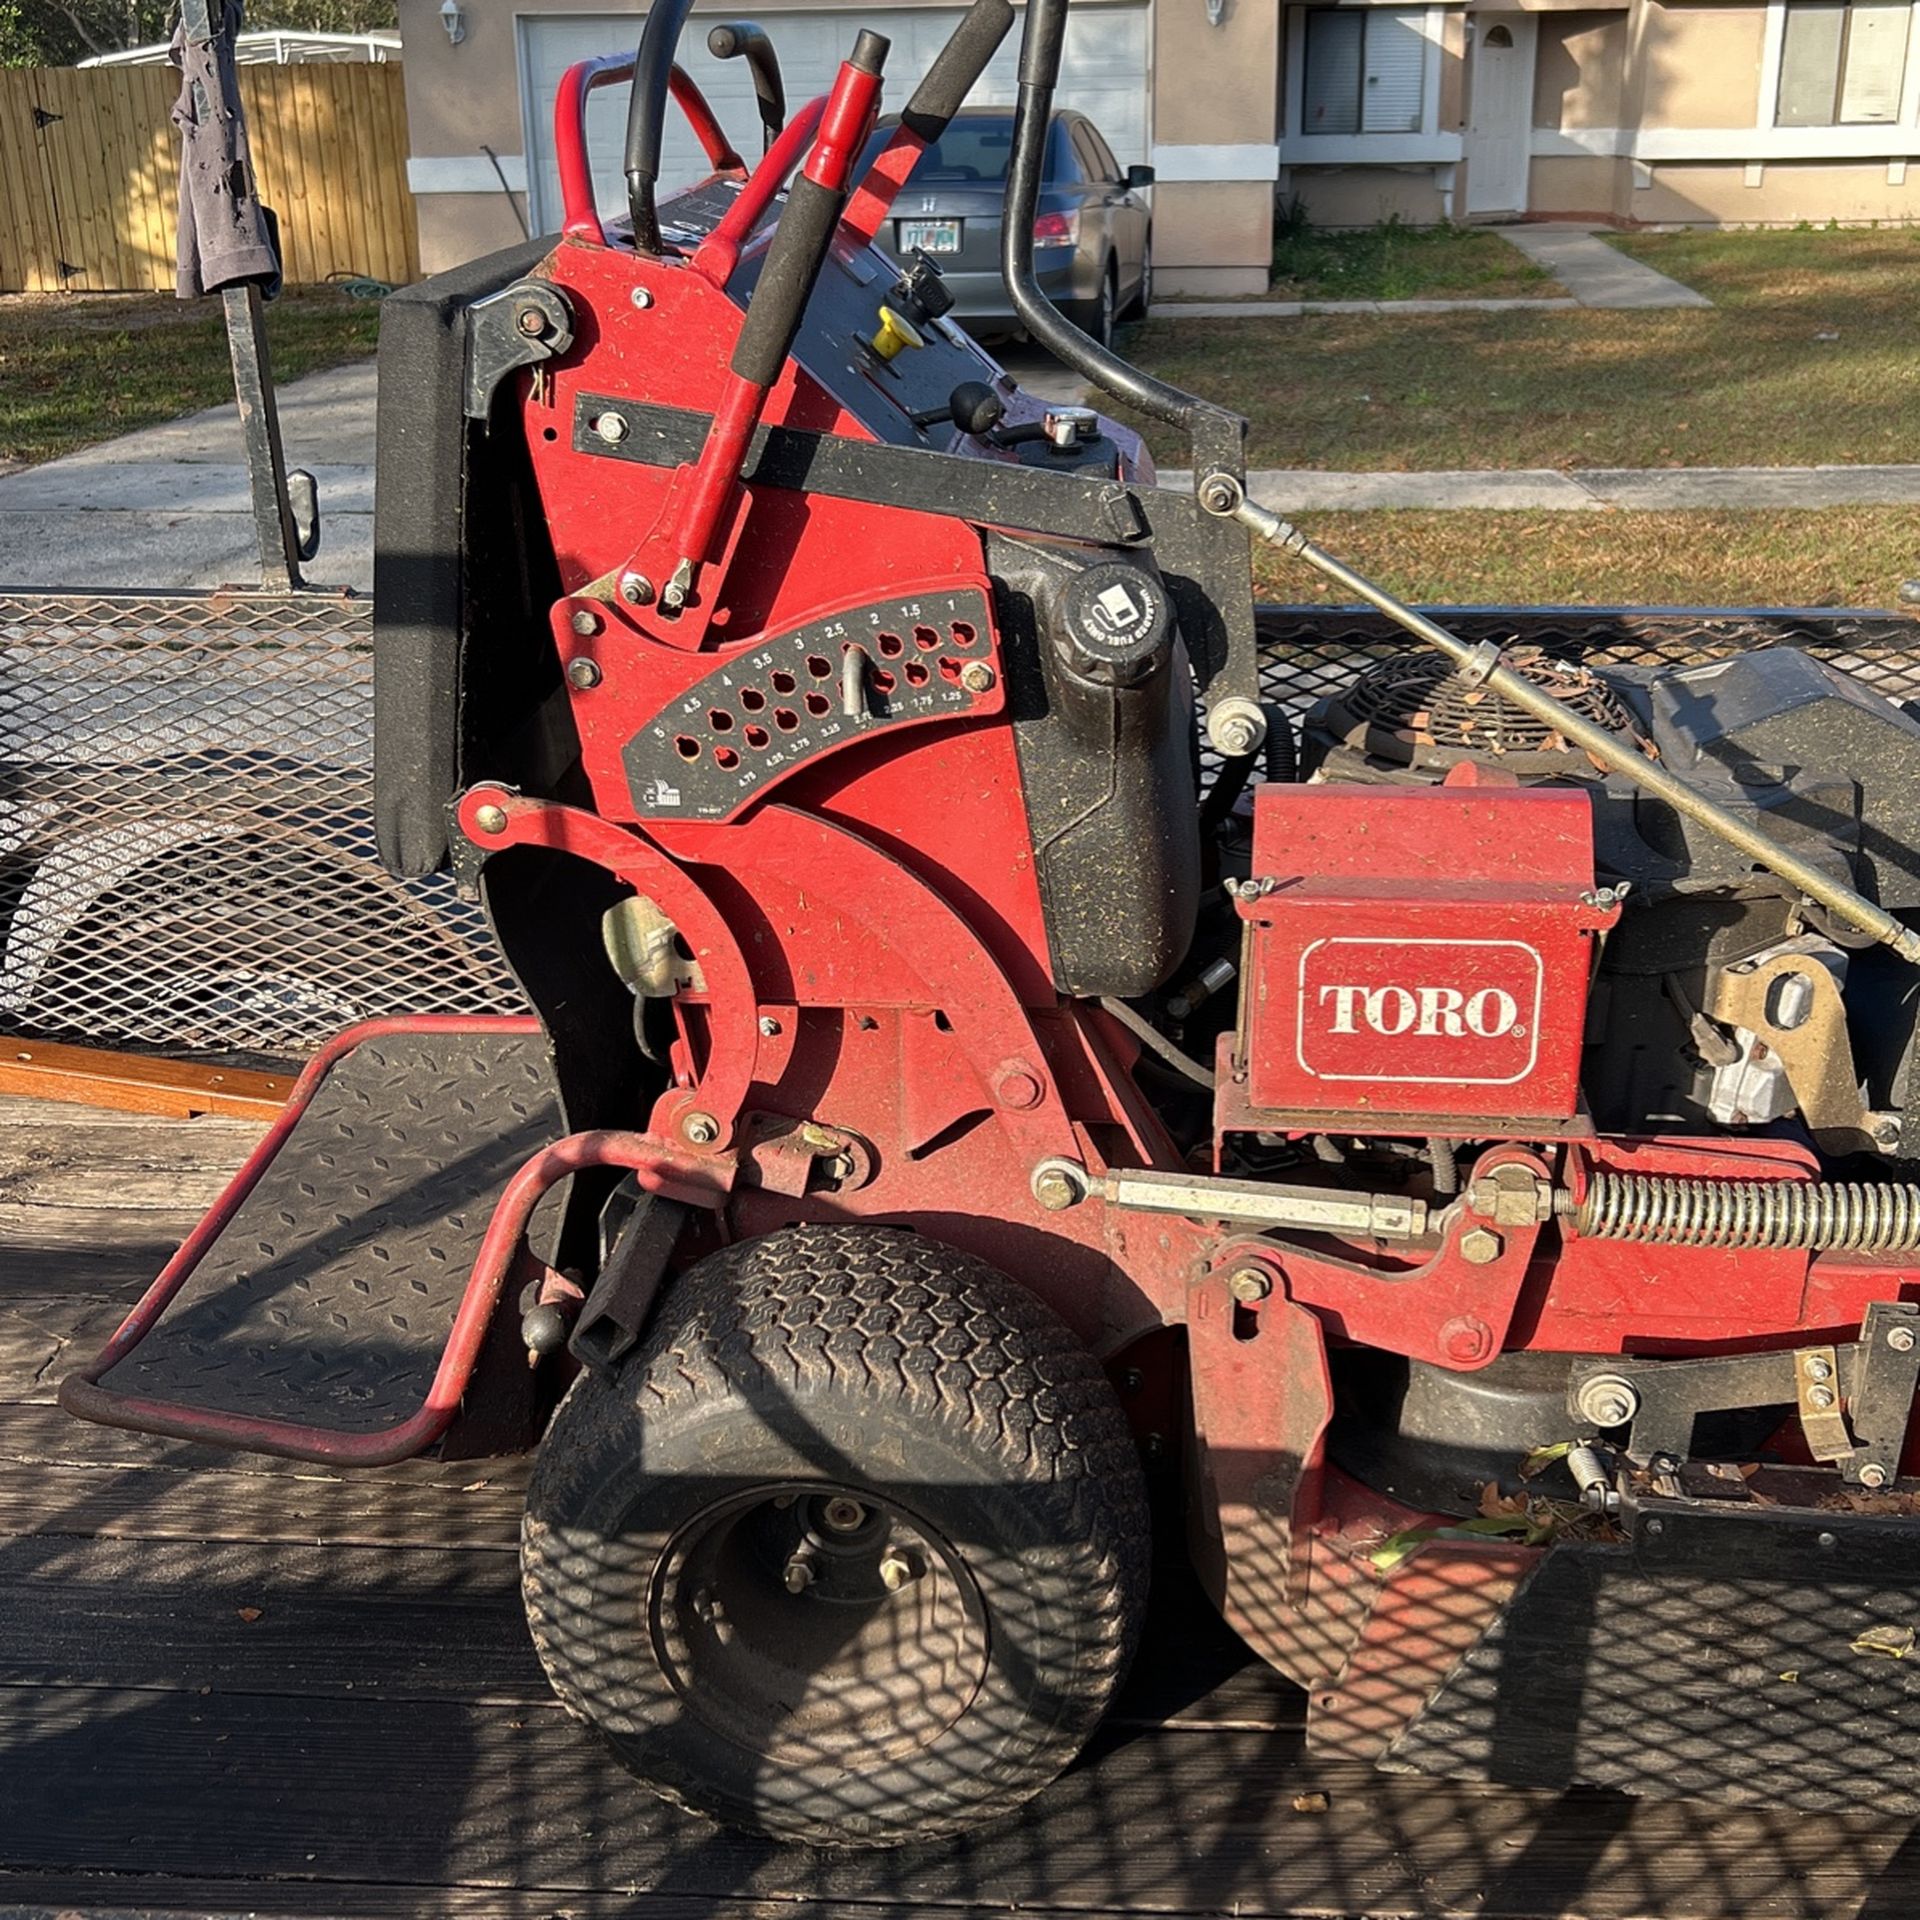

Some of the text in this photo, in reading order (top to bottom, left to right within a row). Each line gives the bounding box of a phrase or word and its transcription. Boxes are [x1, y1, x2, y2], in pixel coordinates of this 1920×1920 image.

[1082, 618, 1106, 642] ONLY
[1107, 634, 1135, 647] FUEL
[653, 599, 955, 739] 5 4.5 4 3.5 3 2.5 2 1.5 1
[739, 771, 757, 787] 4.75
[790, 737, 811, 752] 3.75
[820, 723, 841, 737] 3.25
[912, 695, 933, 707] 1.75
[941, 691, 962, 702] 1.25
[1319, 985, 1518, 1038] TORO
